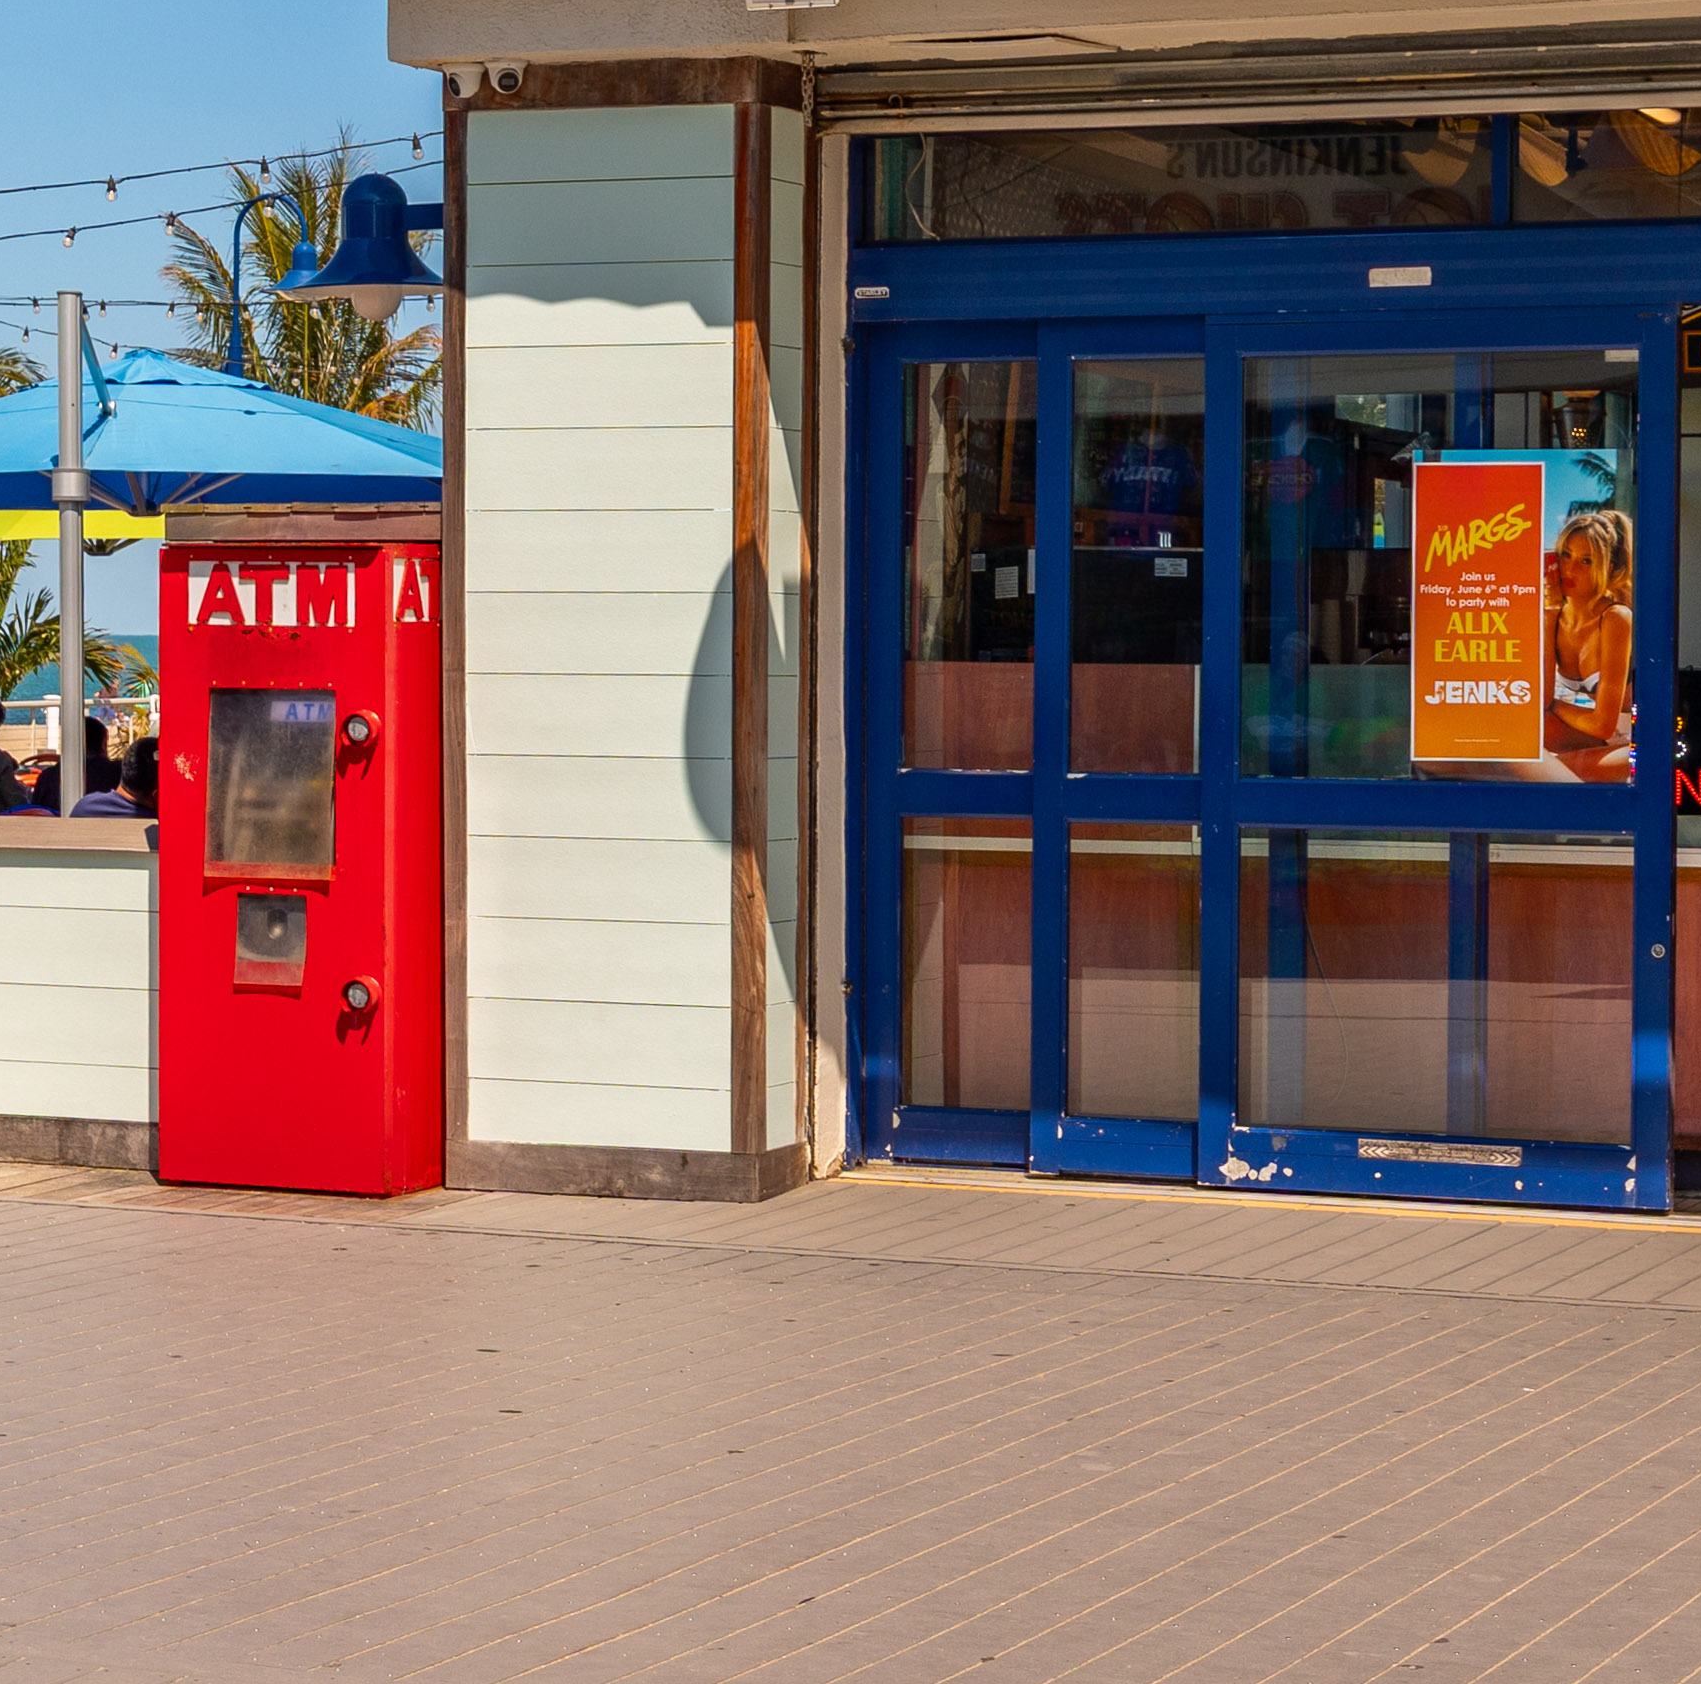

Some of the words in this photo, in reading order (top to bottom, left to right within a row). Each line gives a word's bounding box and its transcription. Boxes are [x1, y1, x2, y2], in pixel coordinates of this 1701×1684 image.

[1424, 502, 1532, 573] MARGS
[1459, 571, 1482, 582] Join
[1483, 573, 1496, 582] us
[197, 563, 348, 626] ATM
[395, 558, 440, 622] AT
[1419, 584, 1455, 595] Friday,
[1457, 584, 1482, 594] June
[1498, 585, 1510, 594] at
[1511, 585, 1536, 597] 9pm
[1446, 598, 1457, 607] to
[1458, 598, 1485, 609] party
[1486, 597, 1510, 607] with
[1445, 611, 1509, 635] ALIX
[1434, 639, 1522, 663] EARLE
[1424, 680, 1532, 705] JENKS
